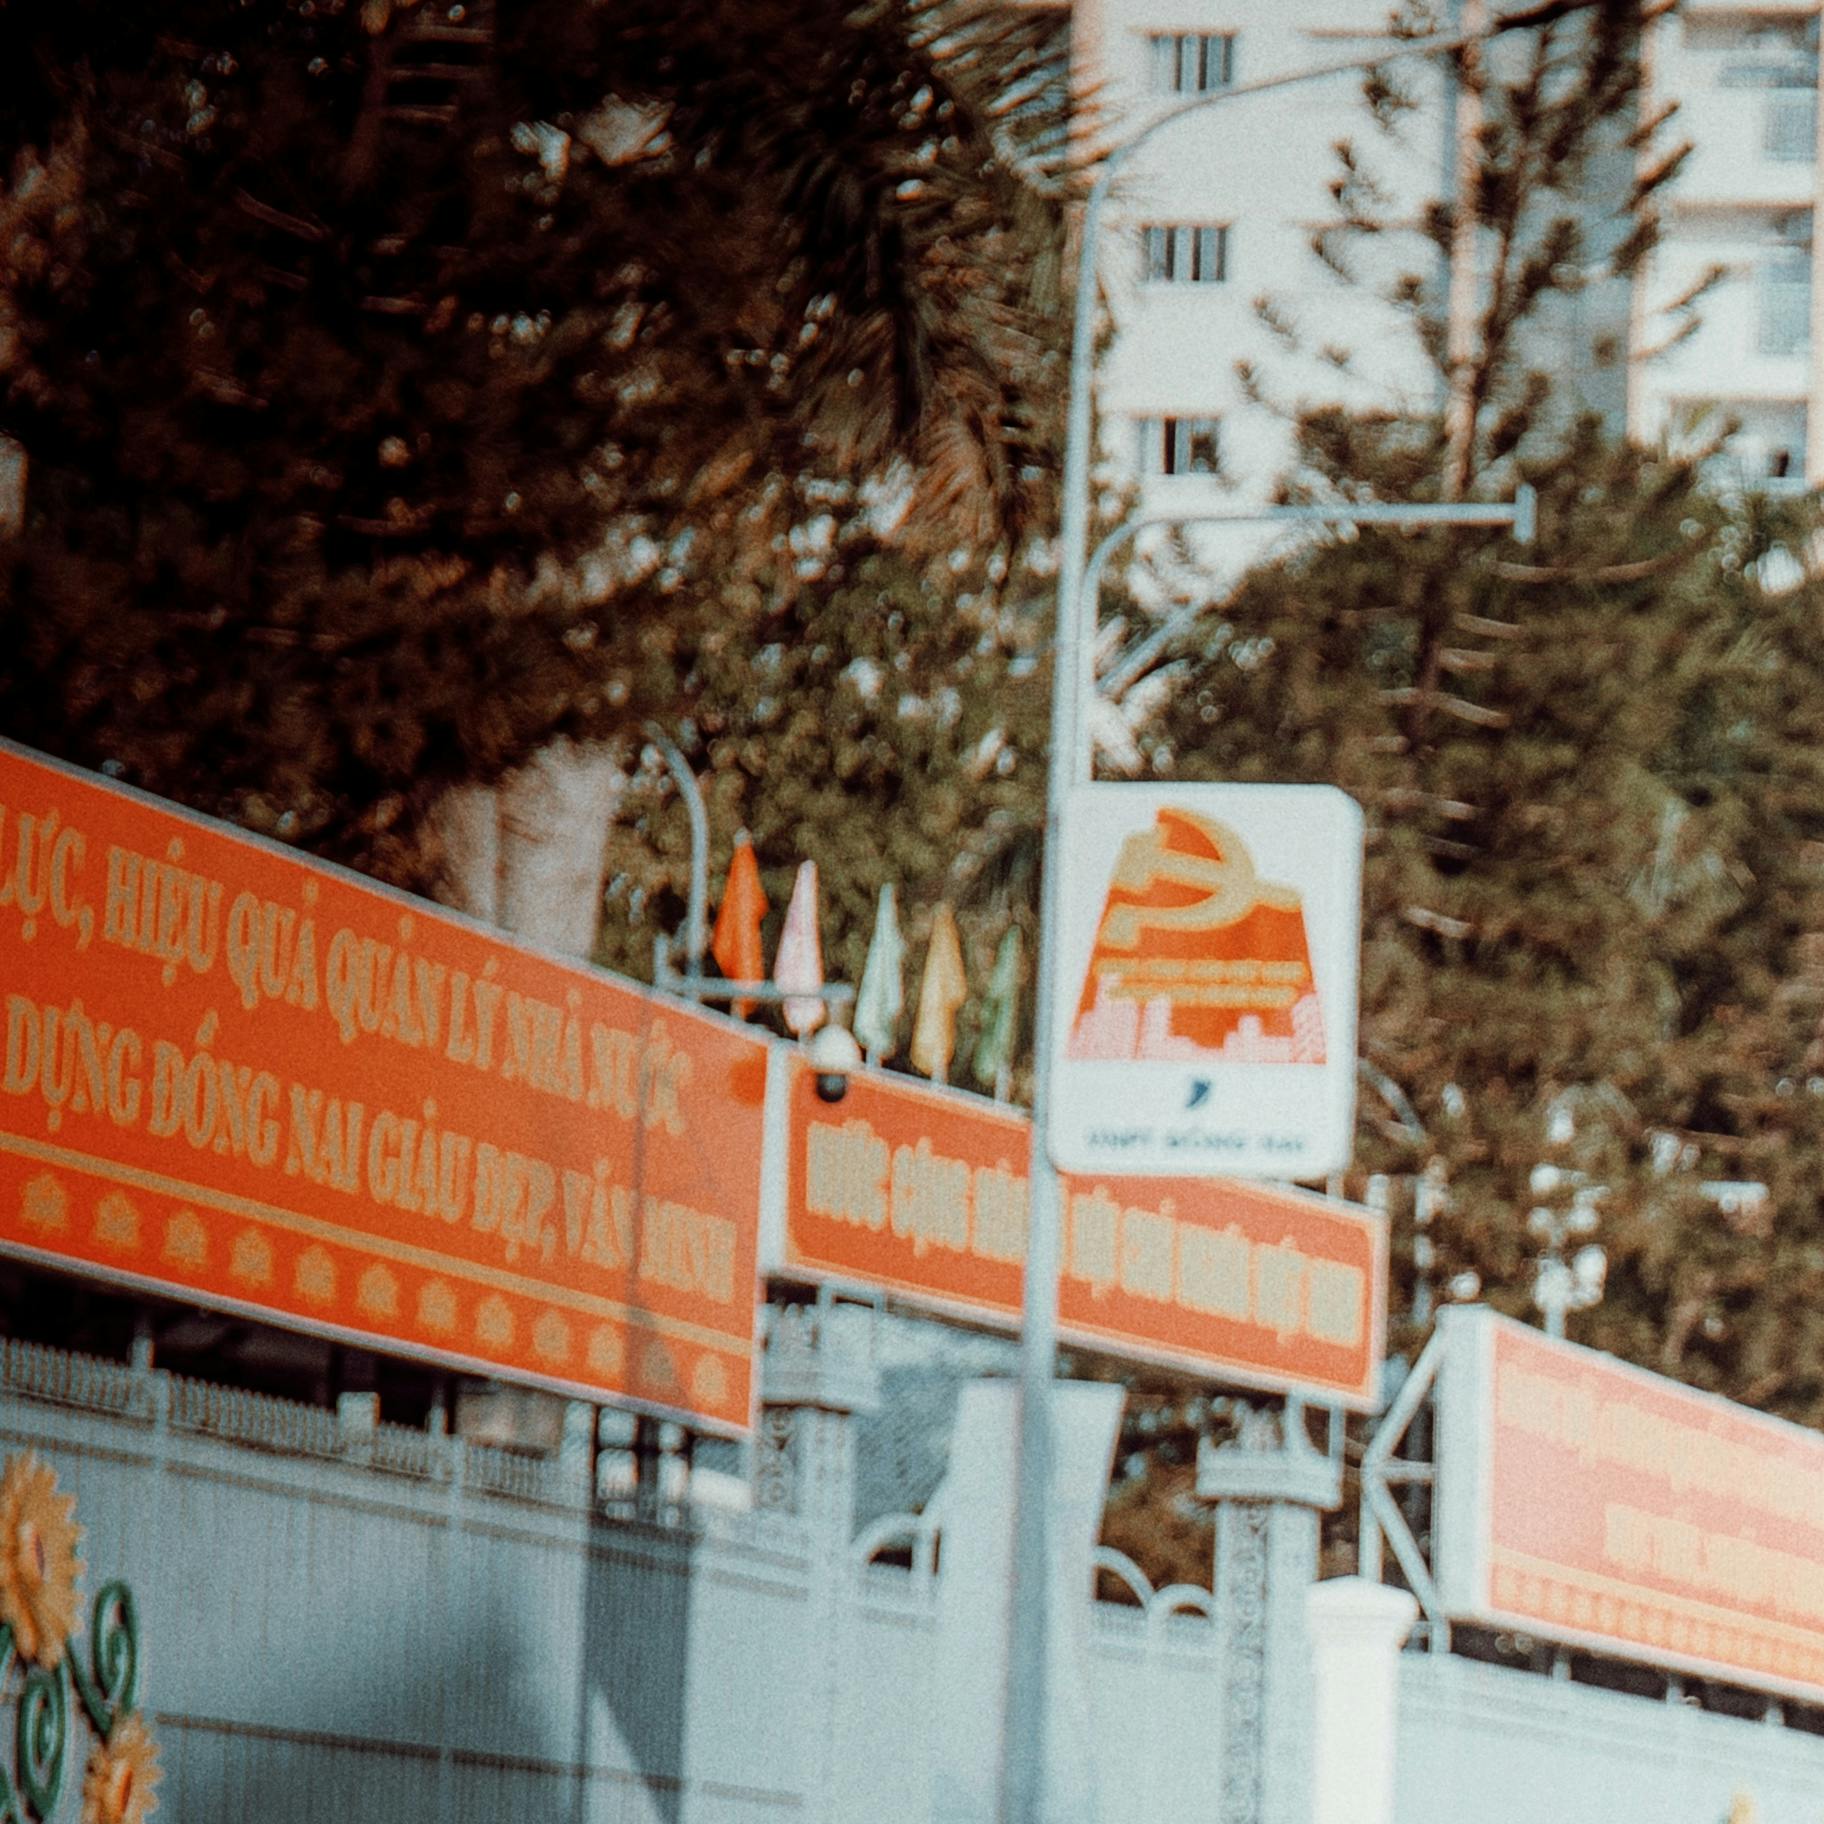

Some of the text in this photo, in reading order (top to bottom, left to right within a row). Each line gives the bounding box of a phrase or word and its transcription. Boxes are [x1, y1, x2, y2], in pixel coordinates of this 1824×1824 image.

[102, 836, 224, 987] HIỆU
[227, 876, 320, 1010] QUẢ
[447, 956, 504, 1073] LÝ
[2, 992, 143, 1133] DỰNG
[284, 1082, 365, 1195] NAI
